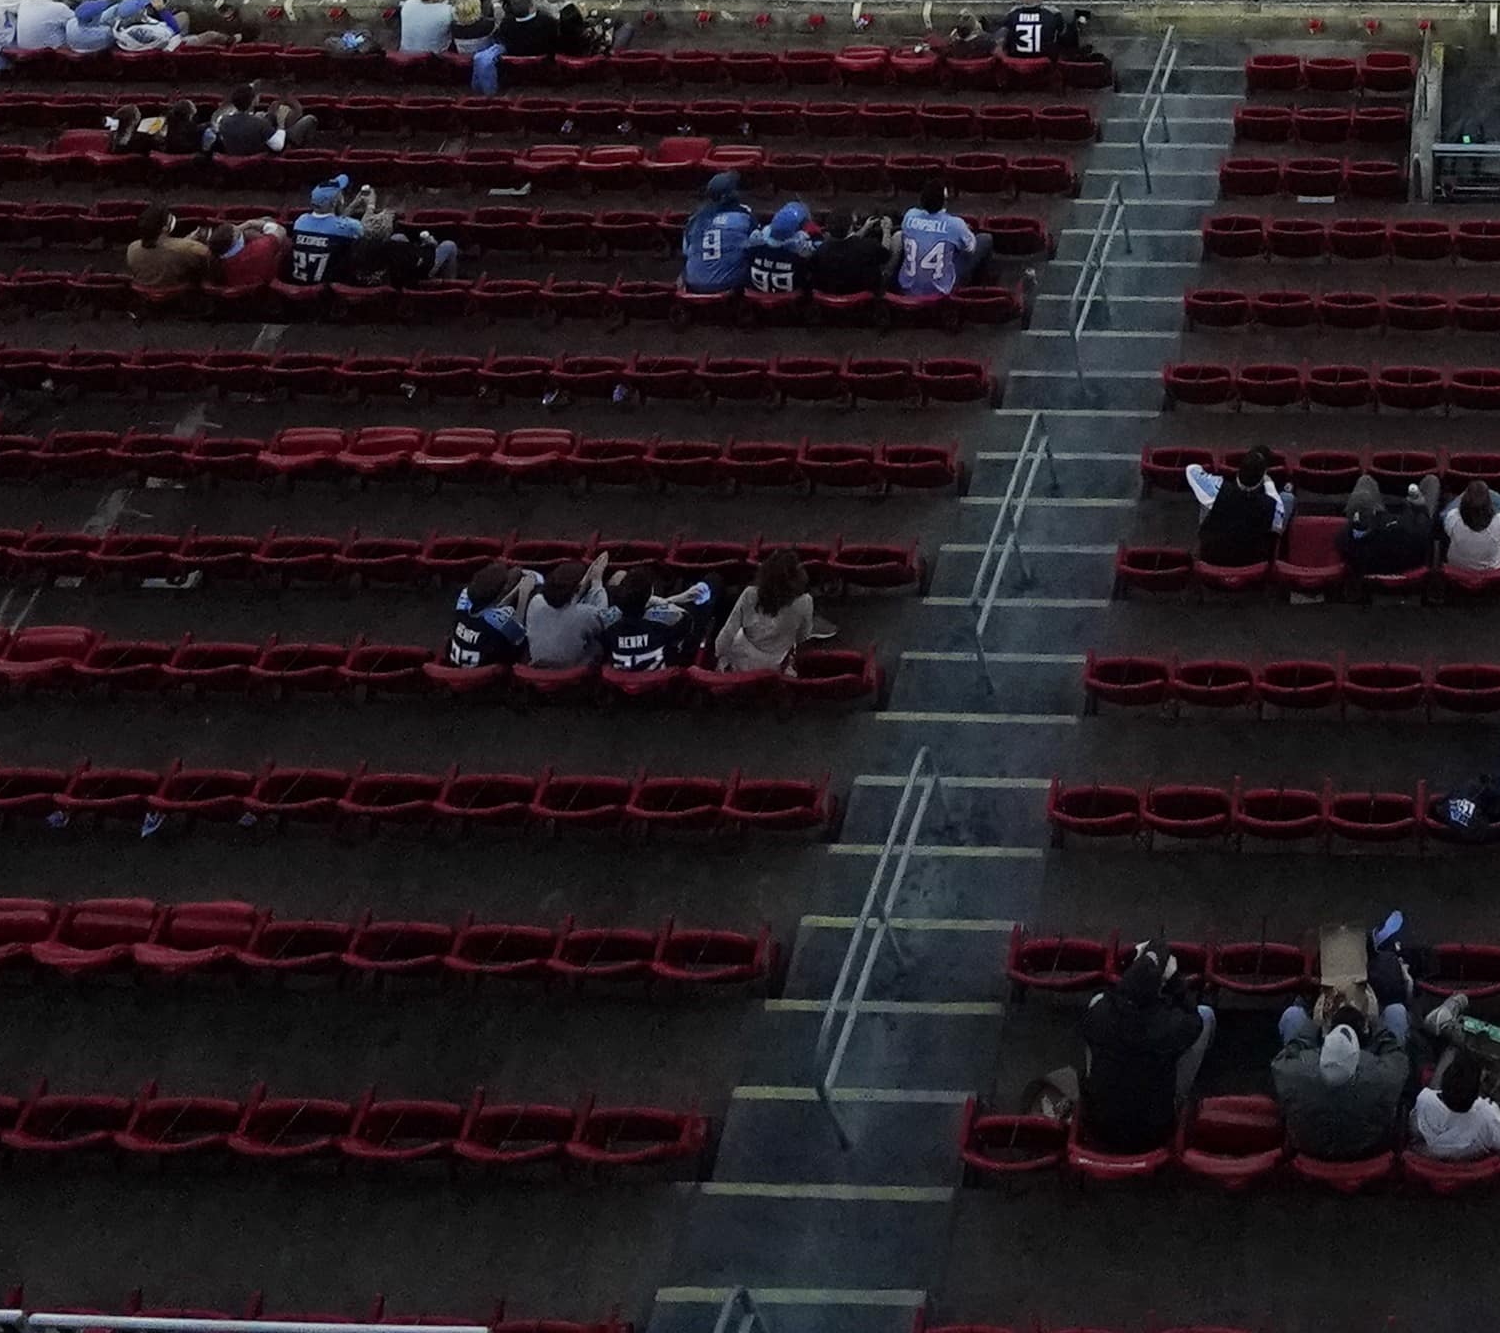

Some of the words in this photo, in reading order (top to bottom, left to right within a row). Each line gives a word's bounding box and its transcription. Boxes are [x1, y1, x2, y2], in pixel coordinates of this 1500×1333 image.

[1015, 24, 1041, 53] 31
[906, 215, 949, 234] CAMPBELL
[618, 633, 650, 650] HENRY
